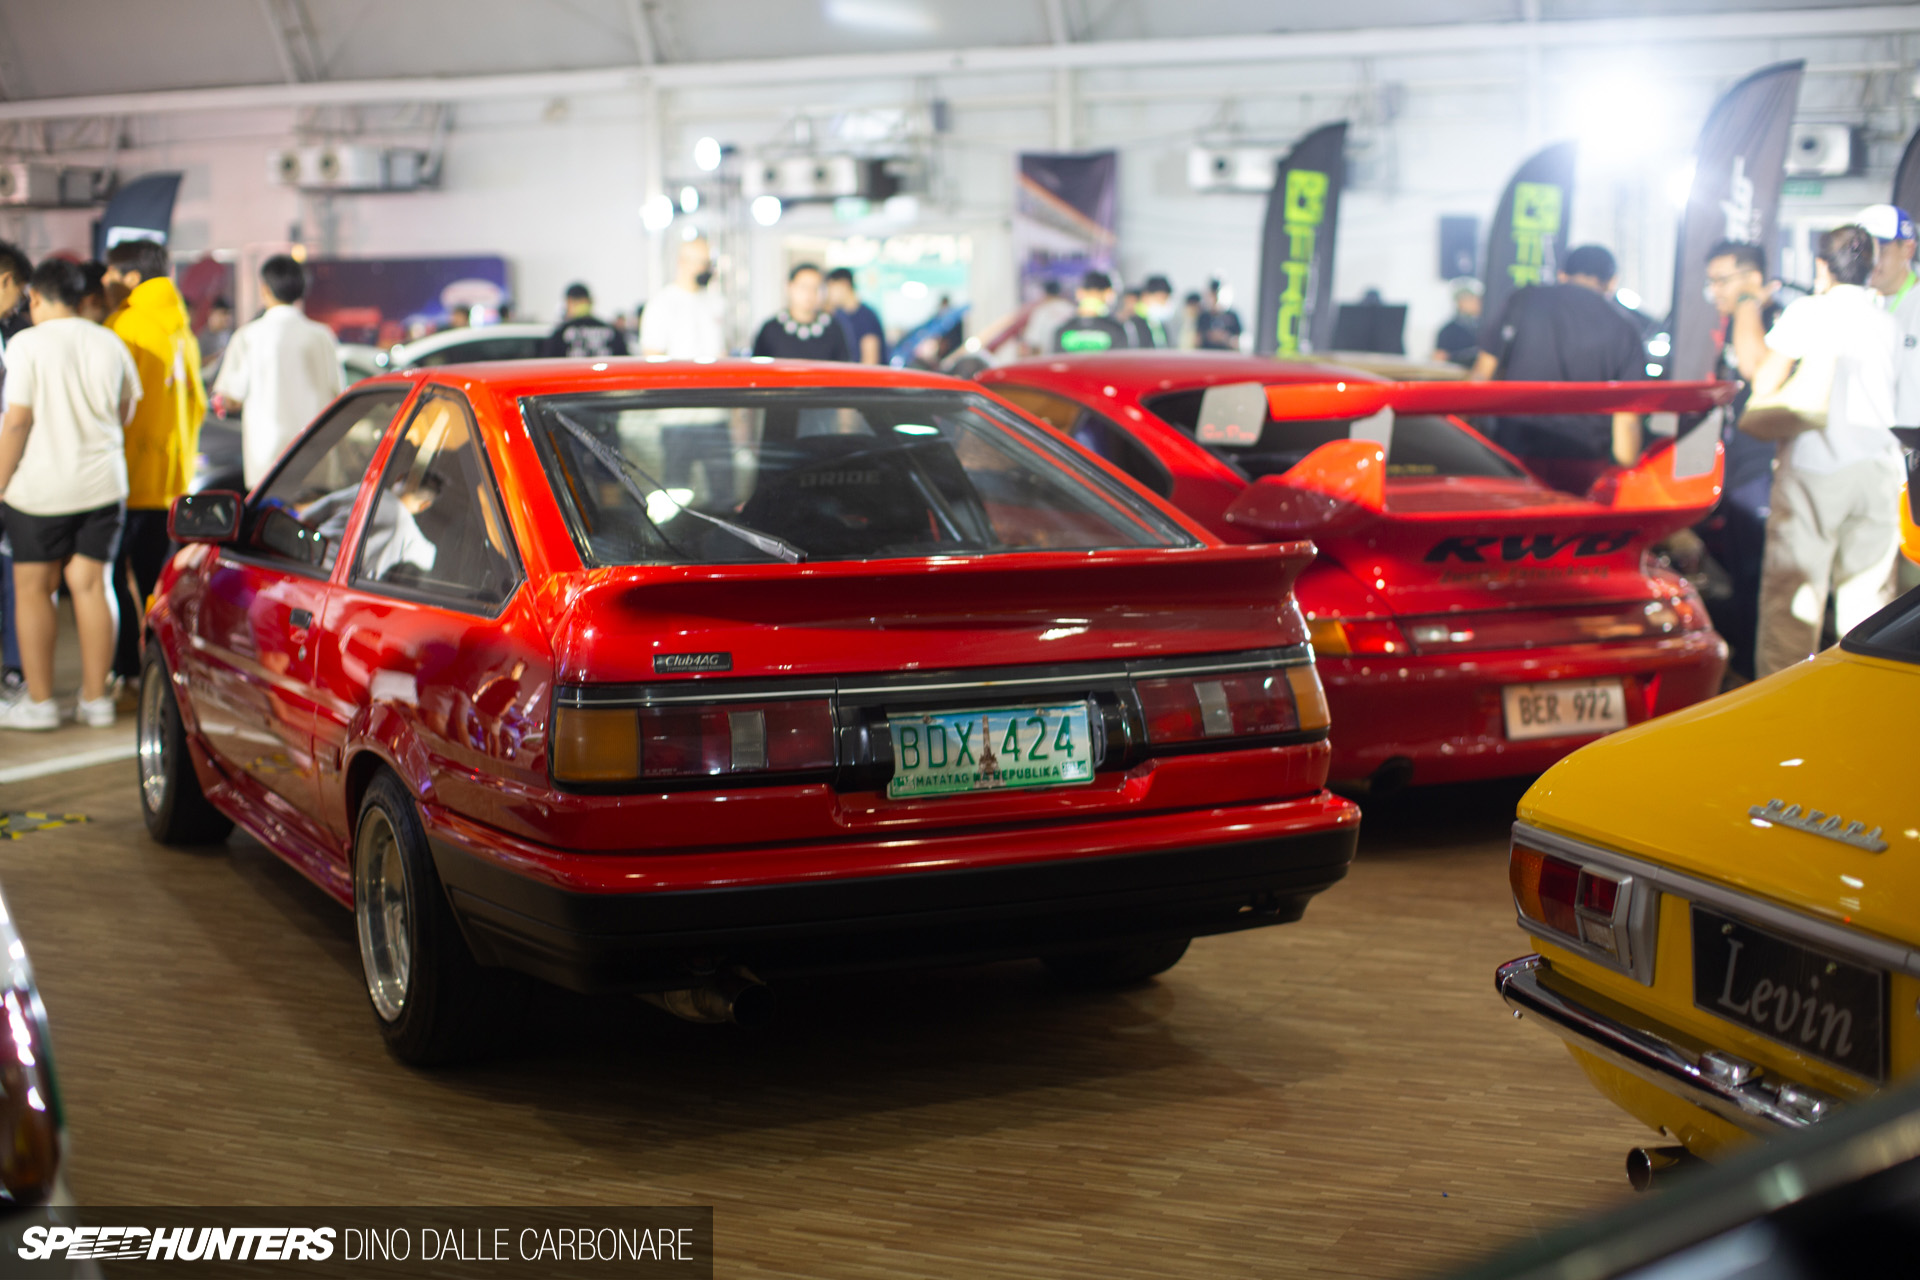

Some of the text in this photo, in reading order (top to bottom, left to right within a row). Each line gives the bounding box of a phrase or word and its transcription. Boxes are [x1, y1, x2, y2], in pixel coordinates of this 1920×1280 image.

[1423, 527, 1642, 563] RWB
[665, 654, 720, 667] Club4AG
[1518, 688, 1614, 726] BER 972
[900, 715, 1075, 770] BDX 424
[915, 773, 969, 786] MATATAG
[993, 766, 1060, 781] REPUBLIKA
[1717, 938, 1853, 1057] Levin
